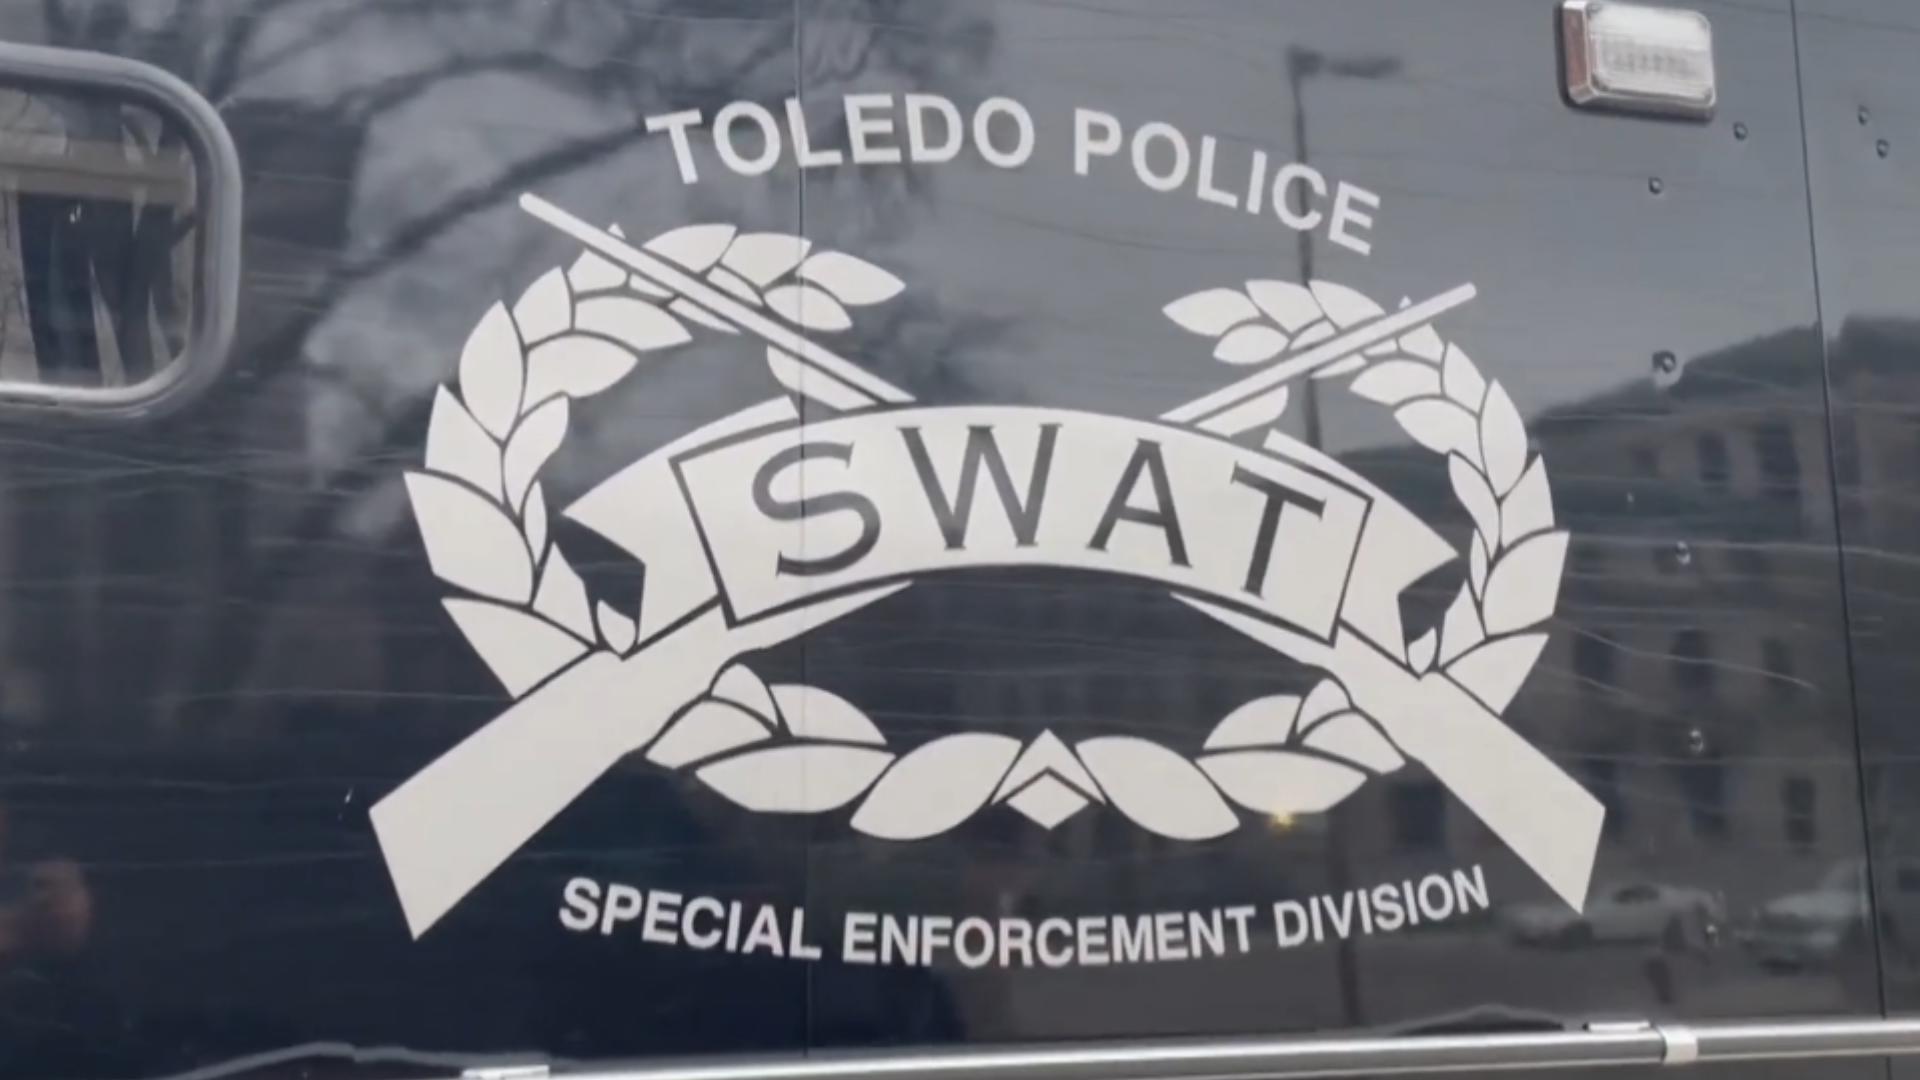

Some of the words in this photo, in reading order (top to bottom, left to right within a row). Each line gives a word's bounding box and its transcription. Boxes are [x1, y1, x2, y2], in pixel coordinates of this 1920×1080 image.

[645, 93, 1035, 185] TOLEDO
[1073, 108, 1381, 255] POLICE
[752, 423, 1325, 598] SWAT
[559, 877, 821, 960] SPECIAL
[843, 903, 1255, 967] ENFORCEMENT
[1274, 865, 1489, 950] DIVISION
